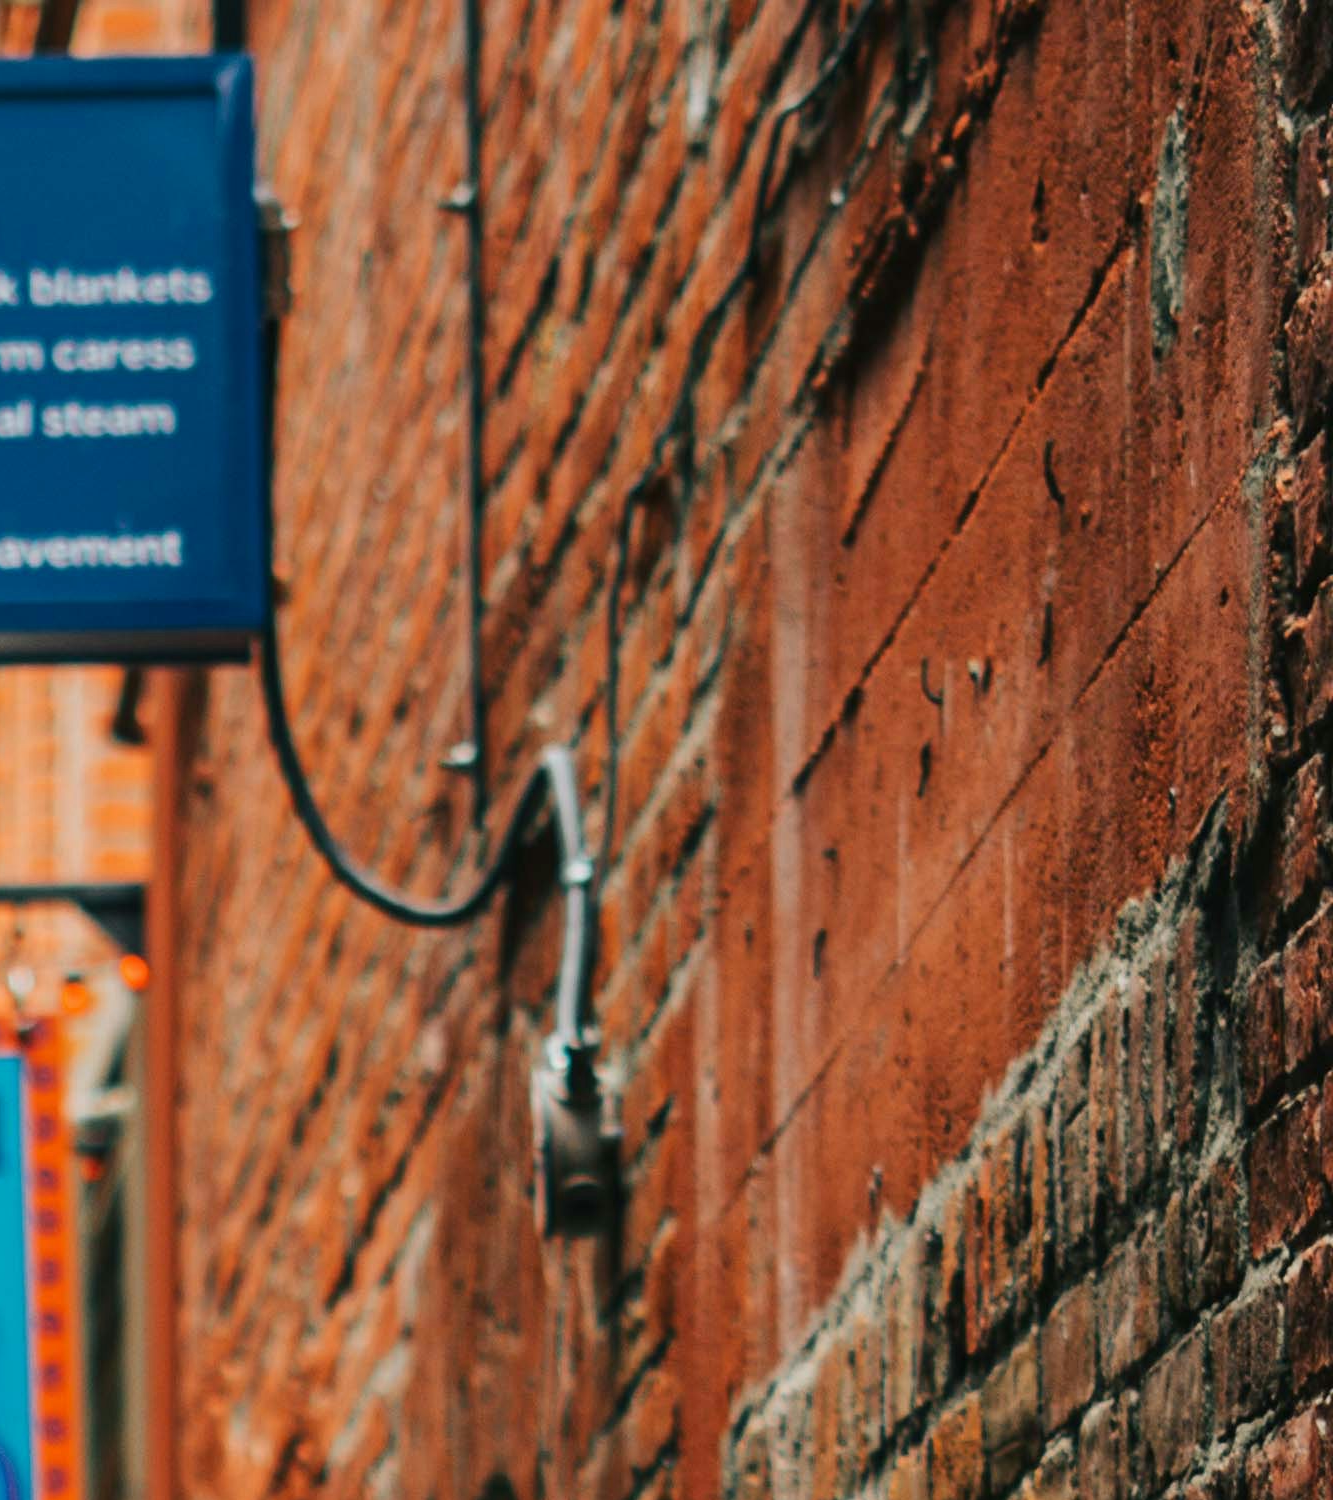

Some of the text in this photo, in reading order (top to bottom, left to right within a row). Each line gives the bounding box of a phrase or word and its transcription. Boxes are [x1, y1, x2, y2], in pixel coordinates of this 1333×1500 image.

[29, 264, 212, 307] blankets
[51, 336, 196, 372] caress
[40, 400, 176, 438] steam
